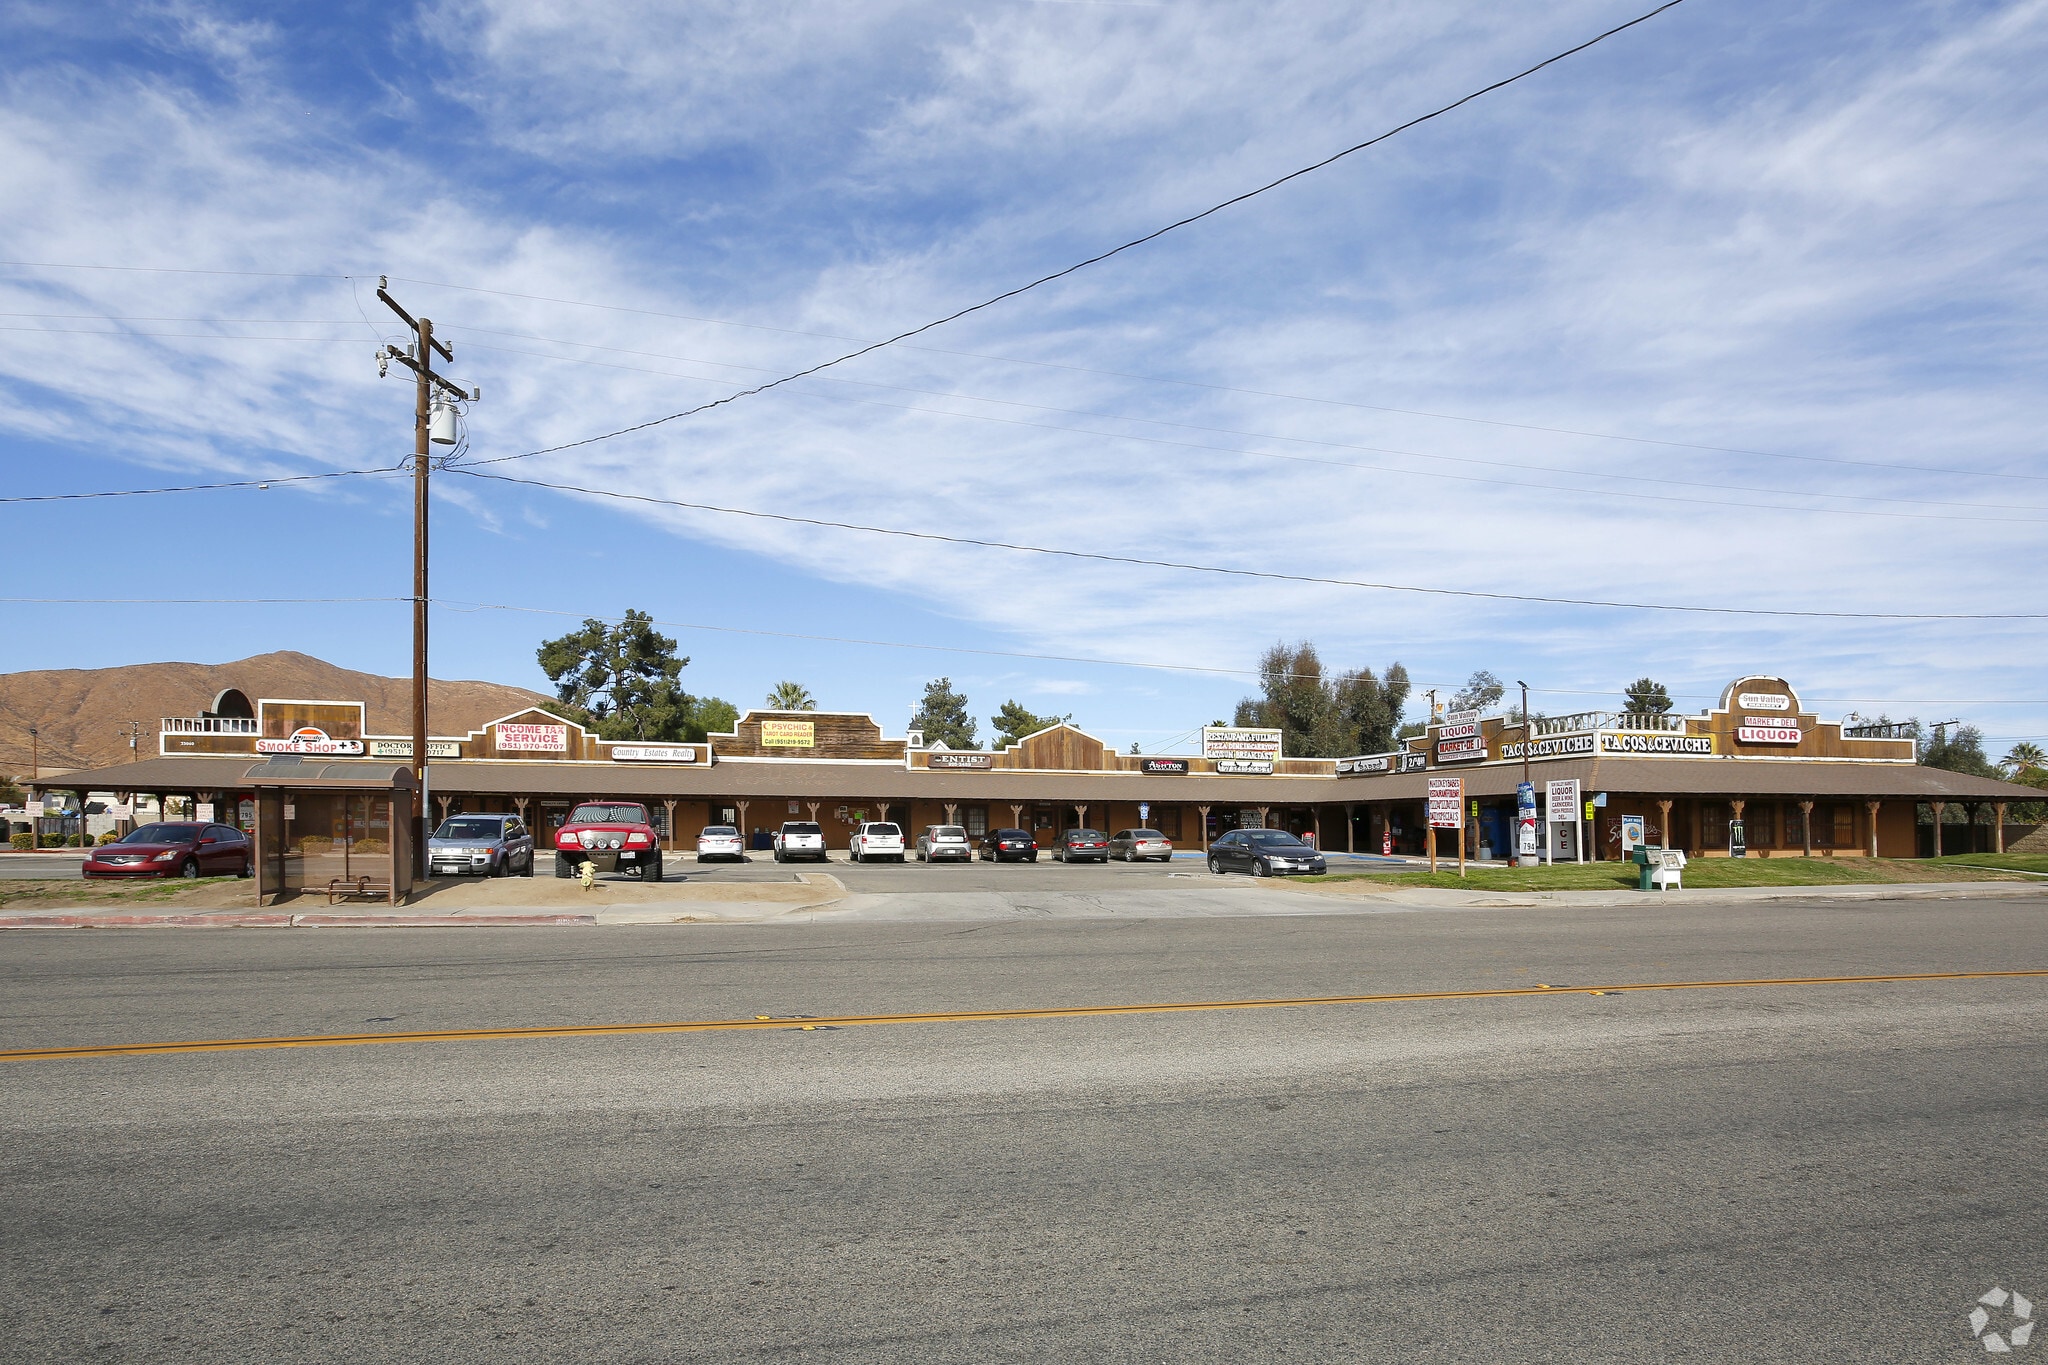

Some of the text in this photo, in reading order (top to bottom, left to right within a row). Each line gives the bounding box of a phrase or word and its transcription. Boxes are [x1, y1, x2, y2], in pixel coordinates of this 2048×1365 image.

[1760, 696, 1786, 704] Valley
[1745, 717, 1775, 726] MARKET
[497, 724, 565, 734] INCOME TAX
[771, 723, 807, 731] PSYCHIC
[1440, 725, 1475, 738] LIQUOR
[504, 733, 559, 743] SERVICE
[1741, 729, 1799, 741] LIQUOR
[258, 741, 301, 752] SMOKE
[305, 741, 337, 753] SHOP
[498, 742, 521, 750] (951)
[612, 747, 694, 760] Country Estates Realty
[1551, 786, 1573, 796] LIQUOR
